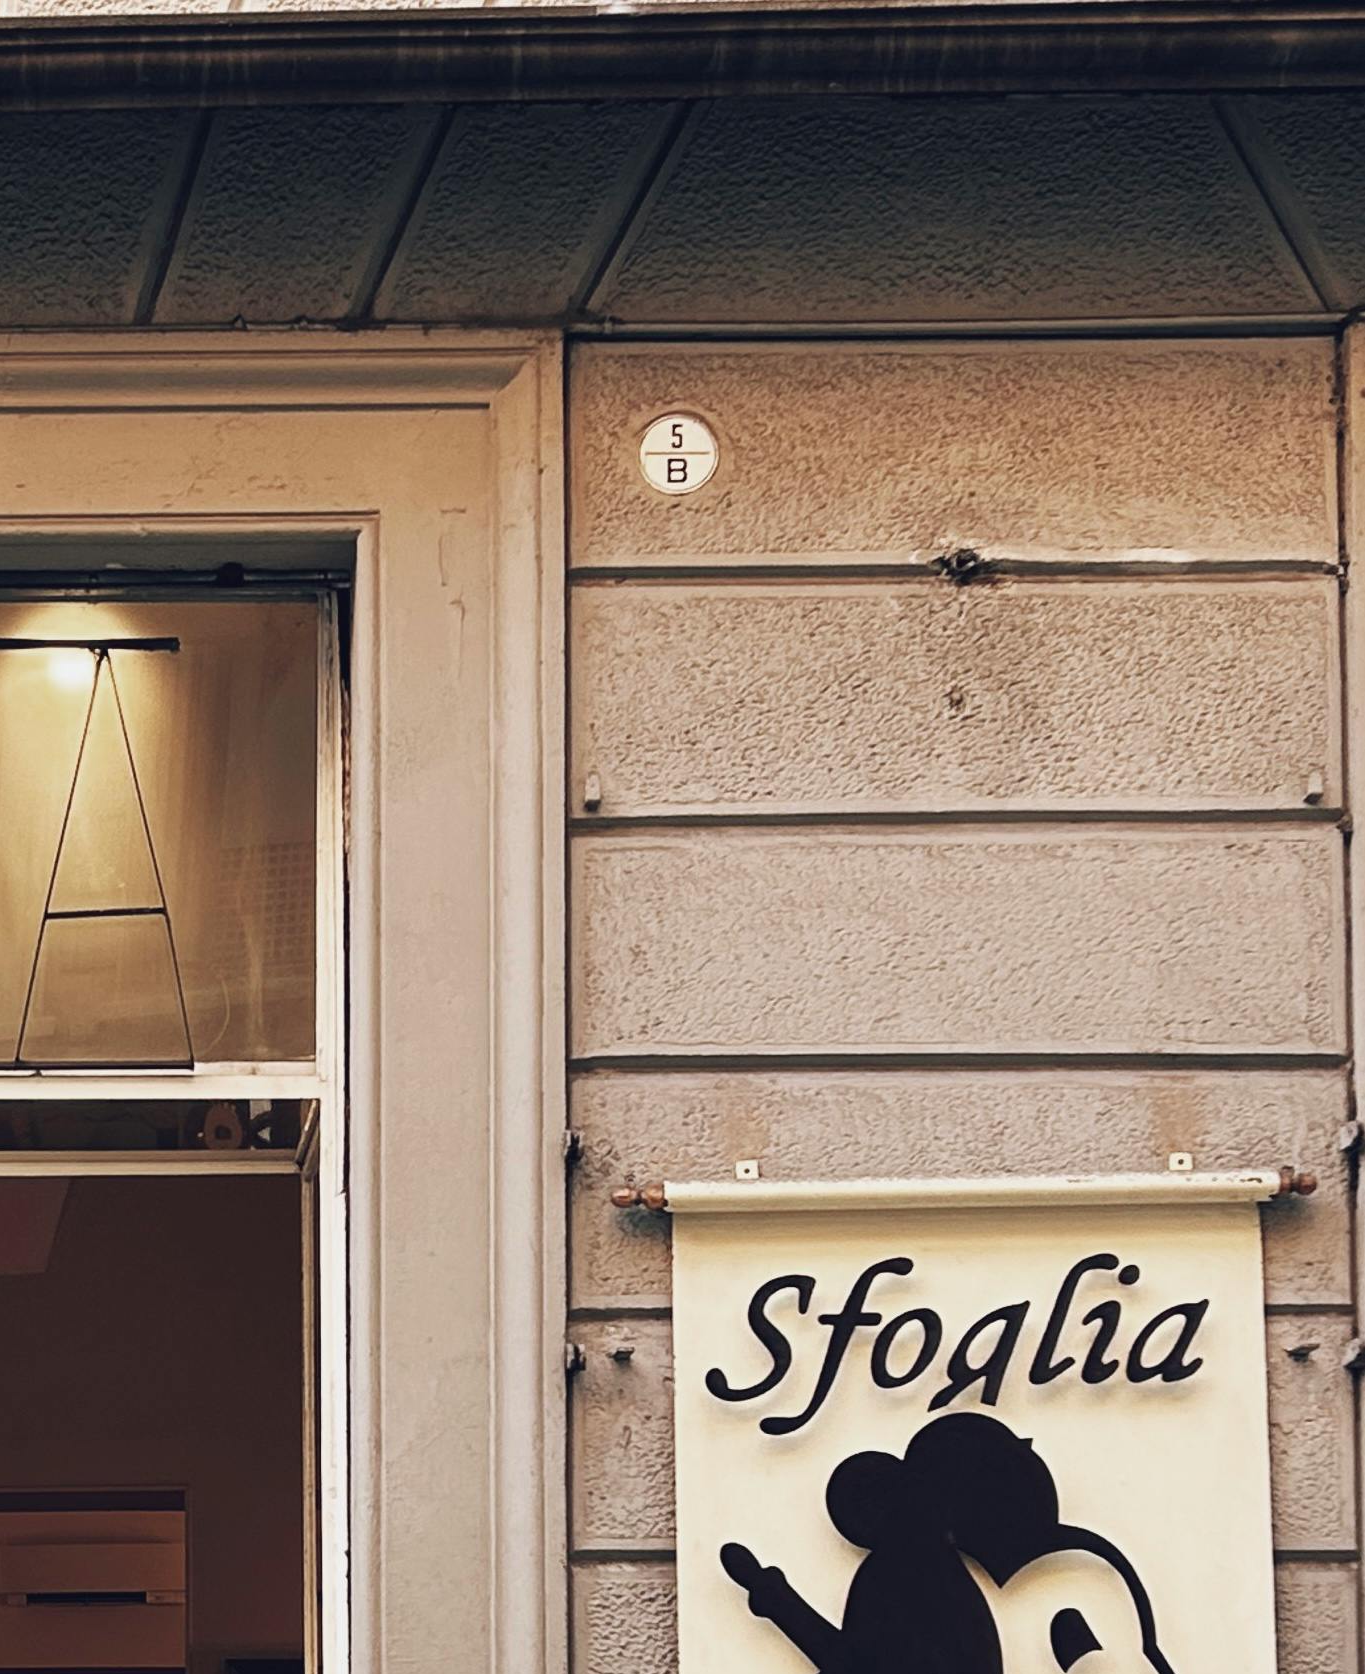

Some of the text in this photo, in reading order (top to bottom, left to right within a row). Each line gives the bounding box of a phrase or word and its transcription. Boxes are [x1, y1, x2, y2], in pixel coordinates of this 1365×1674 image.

[671, 423, 684, 449] 5
[667, 458, 688, 483] B
[705, 1253, 1210, 1436] Sfoglia
